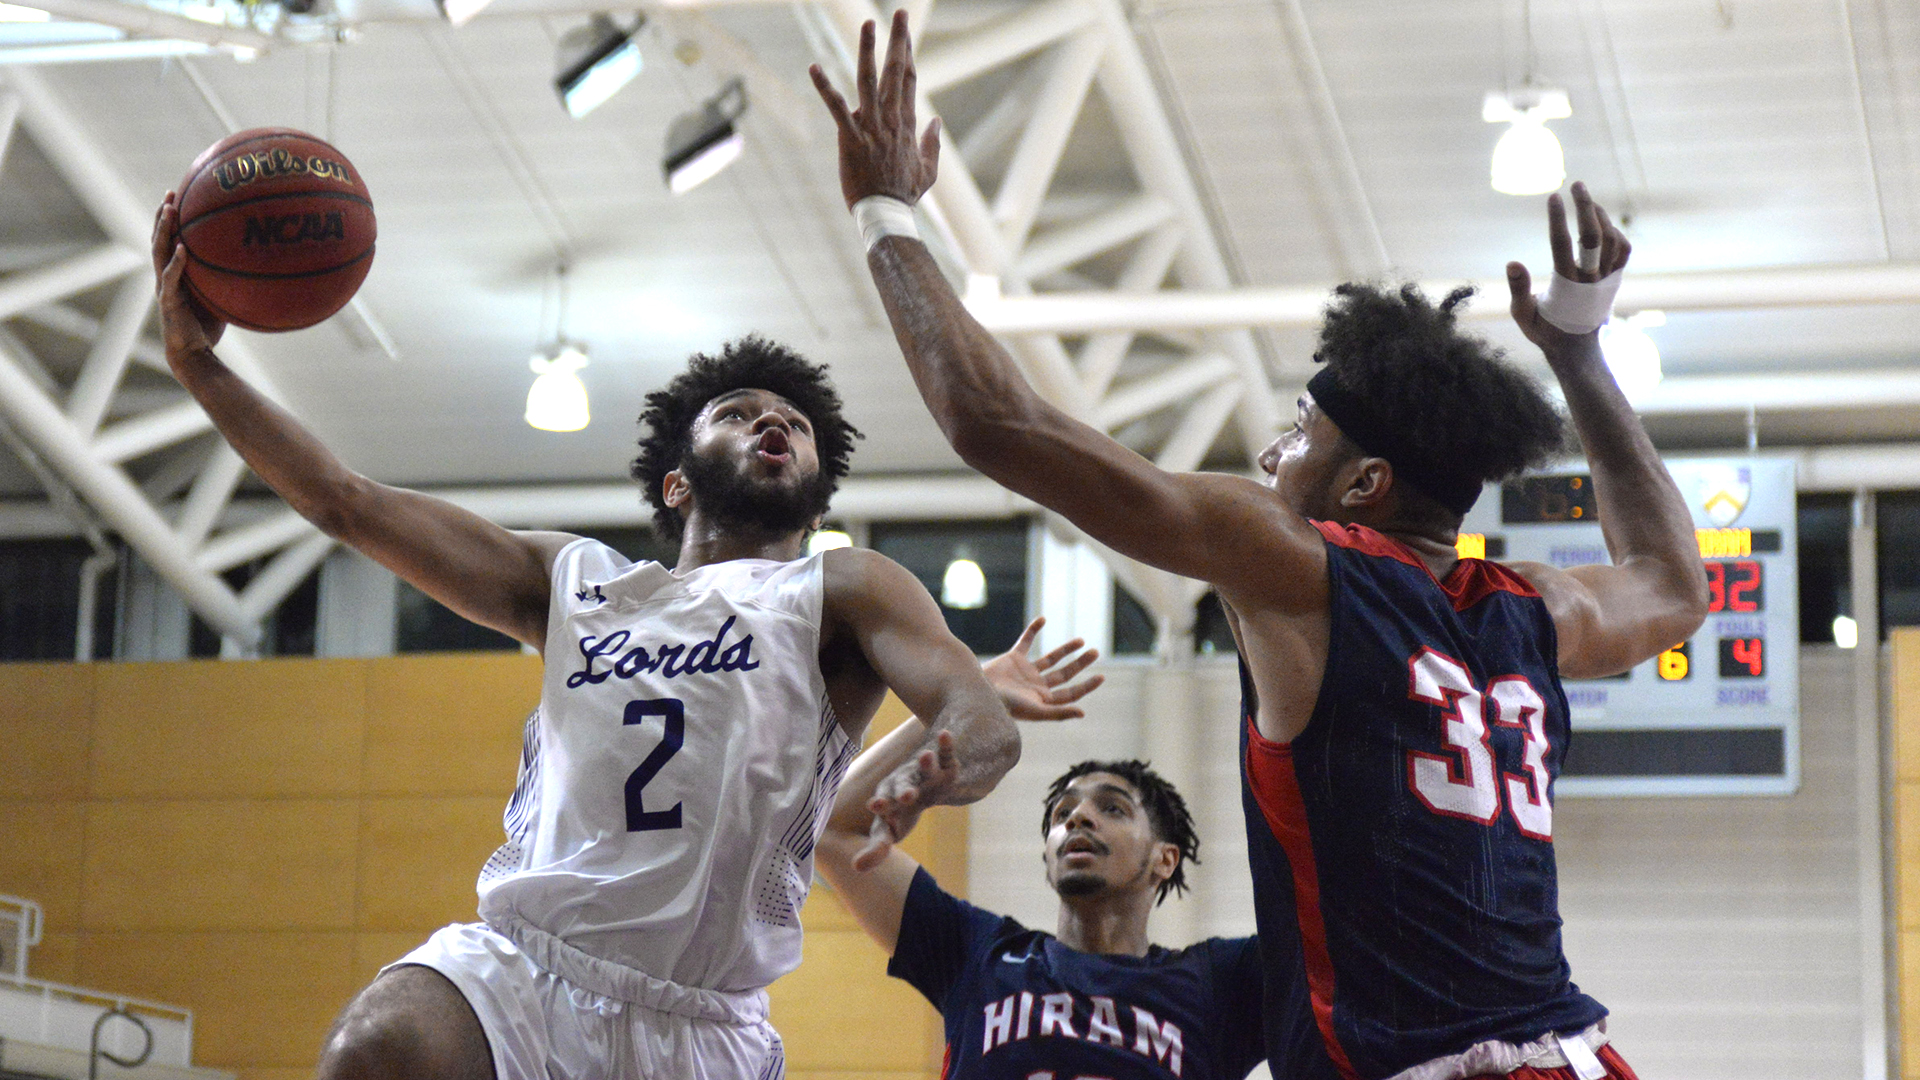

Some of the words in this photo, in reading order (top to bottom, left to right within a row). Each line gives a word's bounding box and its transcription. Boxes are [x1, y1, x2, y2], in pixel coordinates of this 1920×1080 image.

[213, 149, 352, 191] Wilson
[243, 210, 344, 247] NCAA
[566, 615, 760, 689] Lords
[1658, 641, 1688, 680] 6
[1733, 638, 1762, 676] 4
[622, 698, 684, 832] 2
[1406, 644, 1553, 843] 33
[983, 990, 1184, 1077] HIRAM
